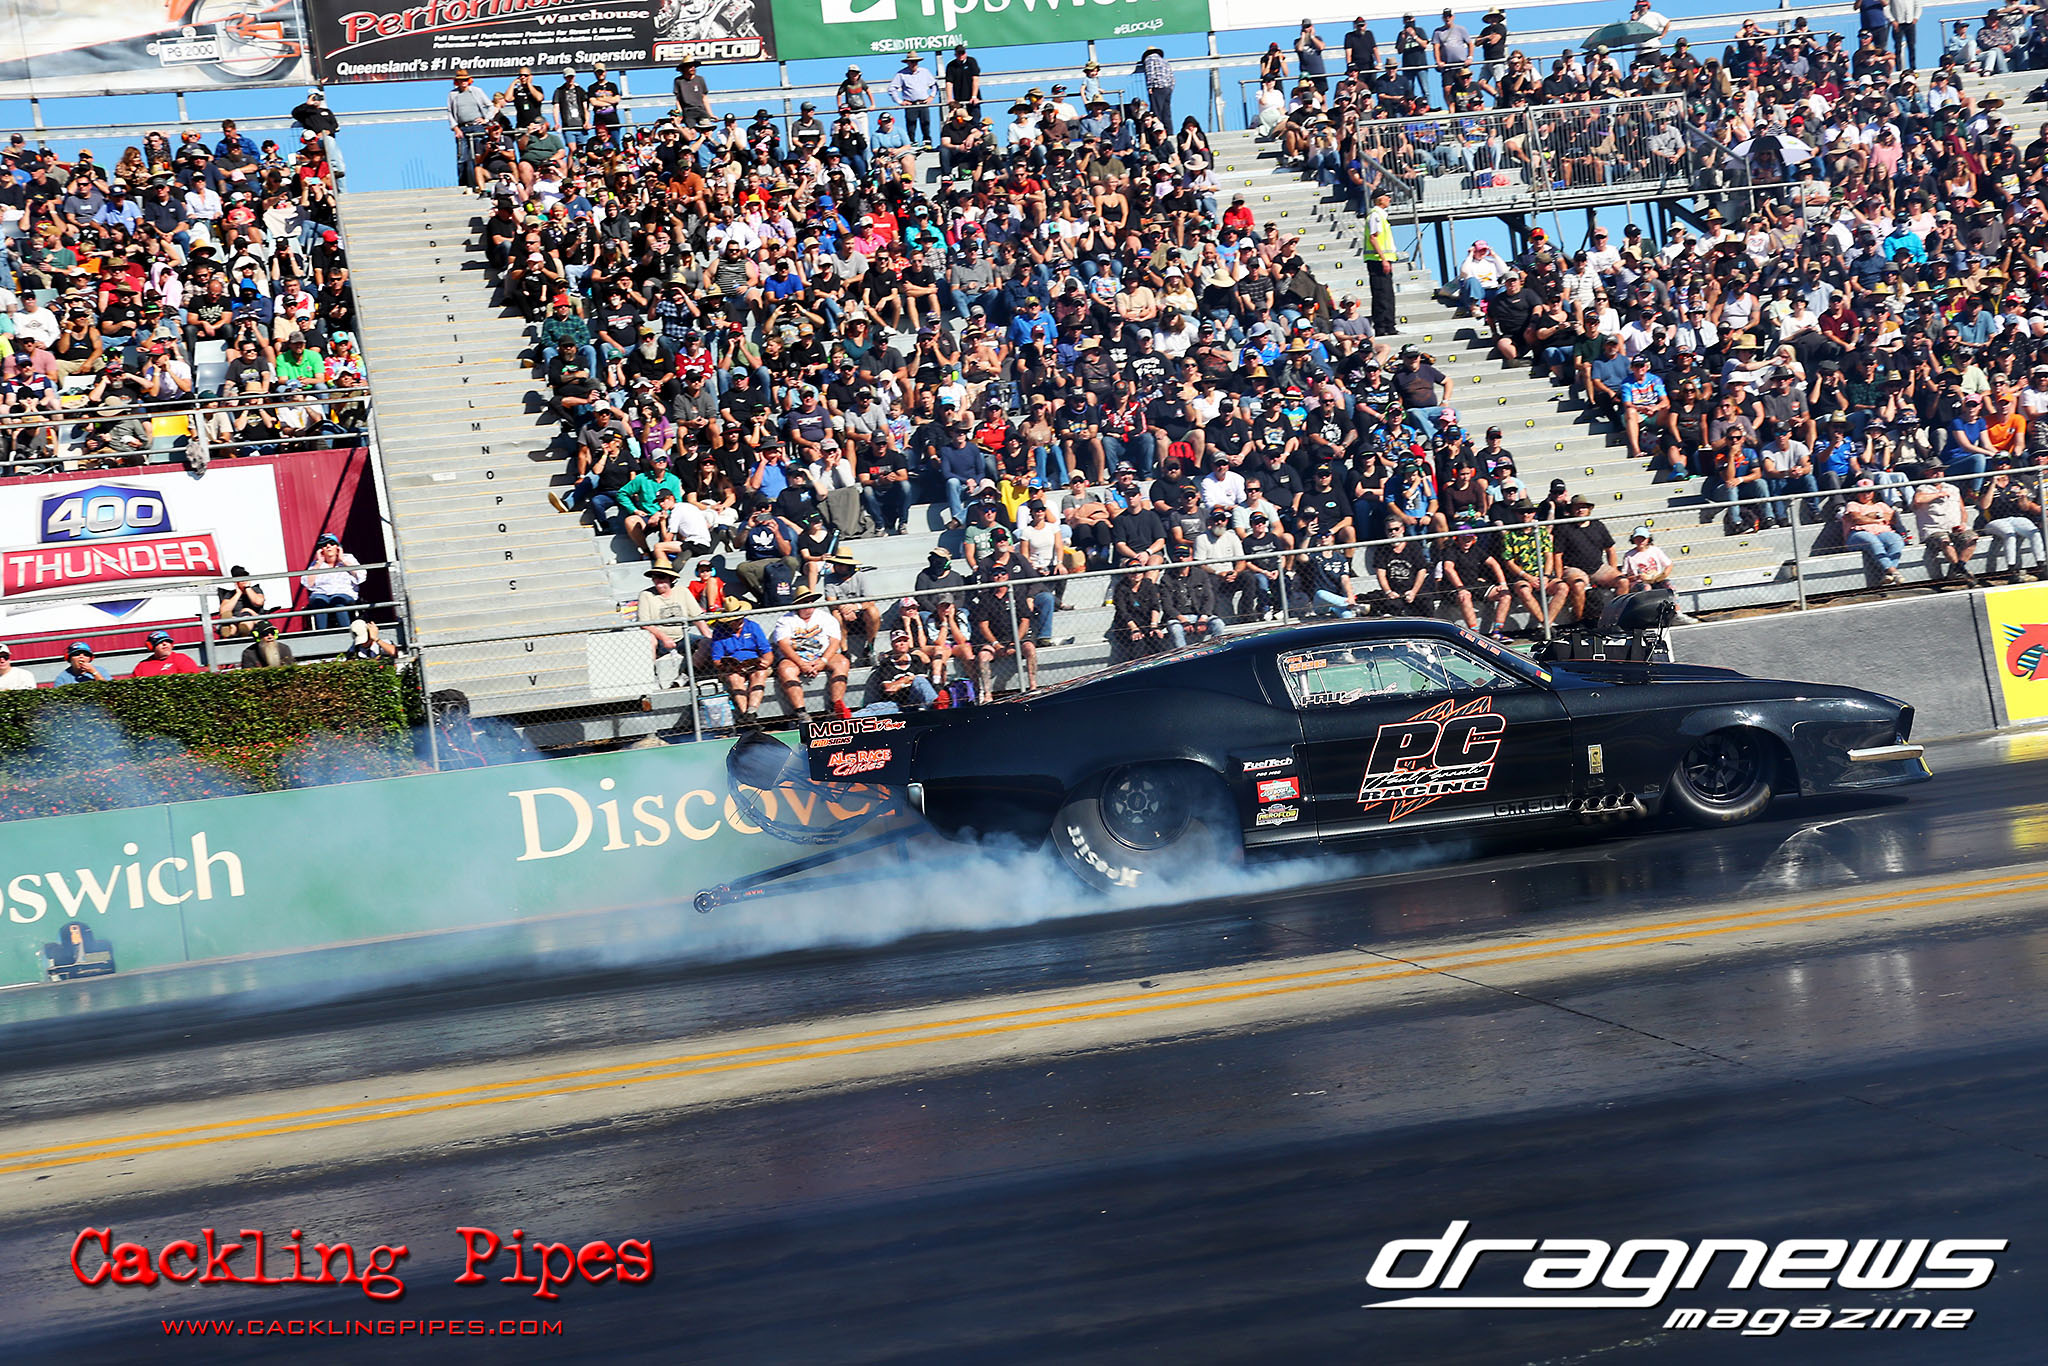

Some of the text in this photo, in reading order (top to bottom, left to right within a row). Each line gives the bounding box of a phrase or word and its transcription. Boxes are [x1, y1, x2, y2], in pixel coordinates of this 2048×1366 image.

[535, 9, 650, 26] Warehouse
[167, 44, 214, 58] PG 2000
[655, 38, 762, 62] AEROFLOW
[336, 48, 647, 76] Queensland's #1 Performance Parts Superstore
[482, 446, 490, 455] N
[495, 496, 503, 505] P
[46, 495, 167, 538] 400
[9, 540, 216, 588] THUNDER
[504, 550, 513, 561] R
[524, 642, 534, 652] U
[528, 675, 537, 686] V
[809, 717, 877, 739] MOITS
[1365, 713, 1507, 778] PC
[856, 748, 893, 763] RACE
[1243, 757, 1293, 771] FuelTech
[1359, 779, 1488, 802] RACING
[508, 776, 897, 862] Discove
[0, 831, 246, 924] swich
